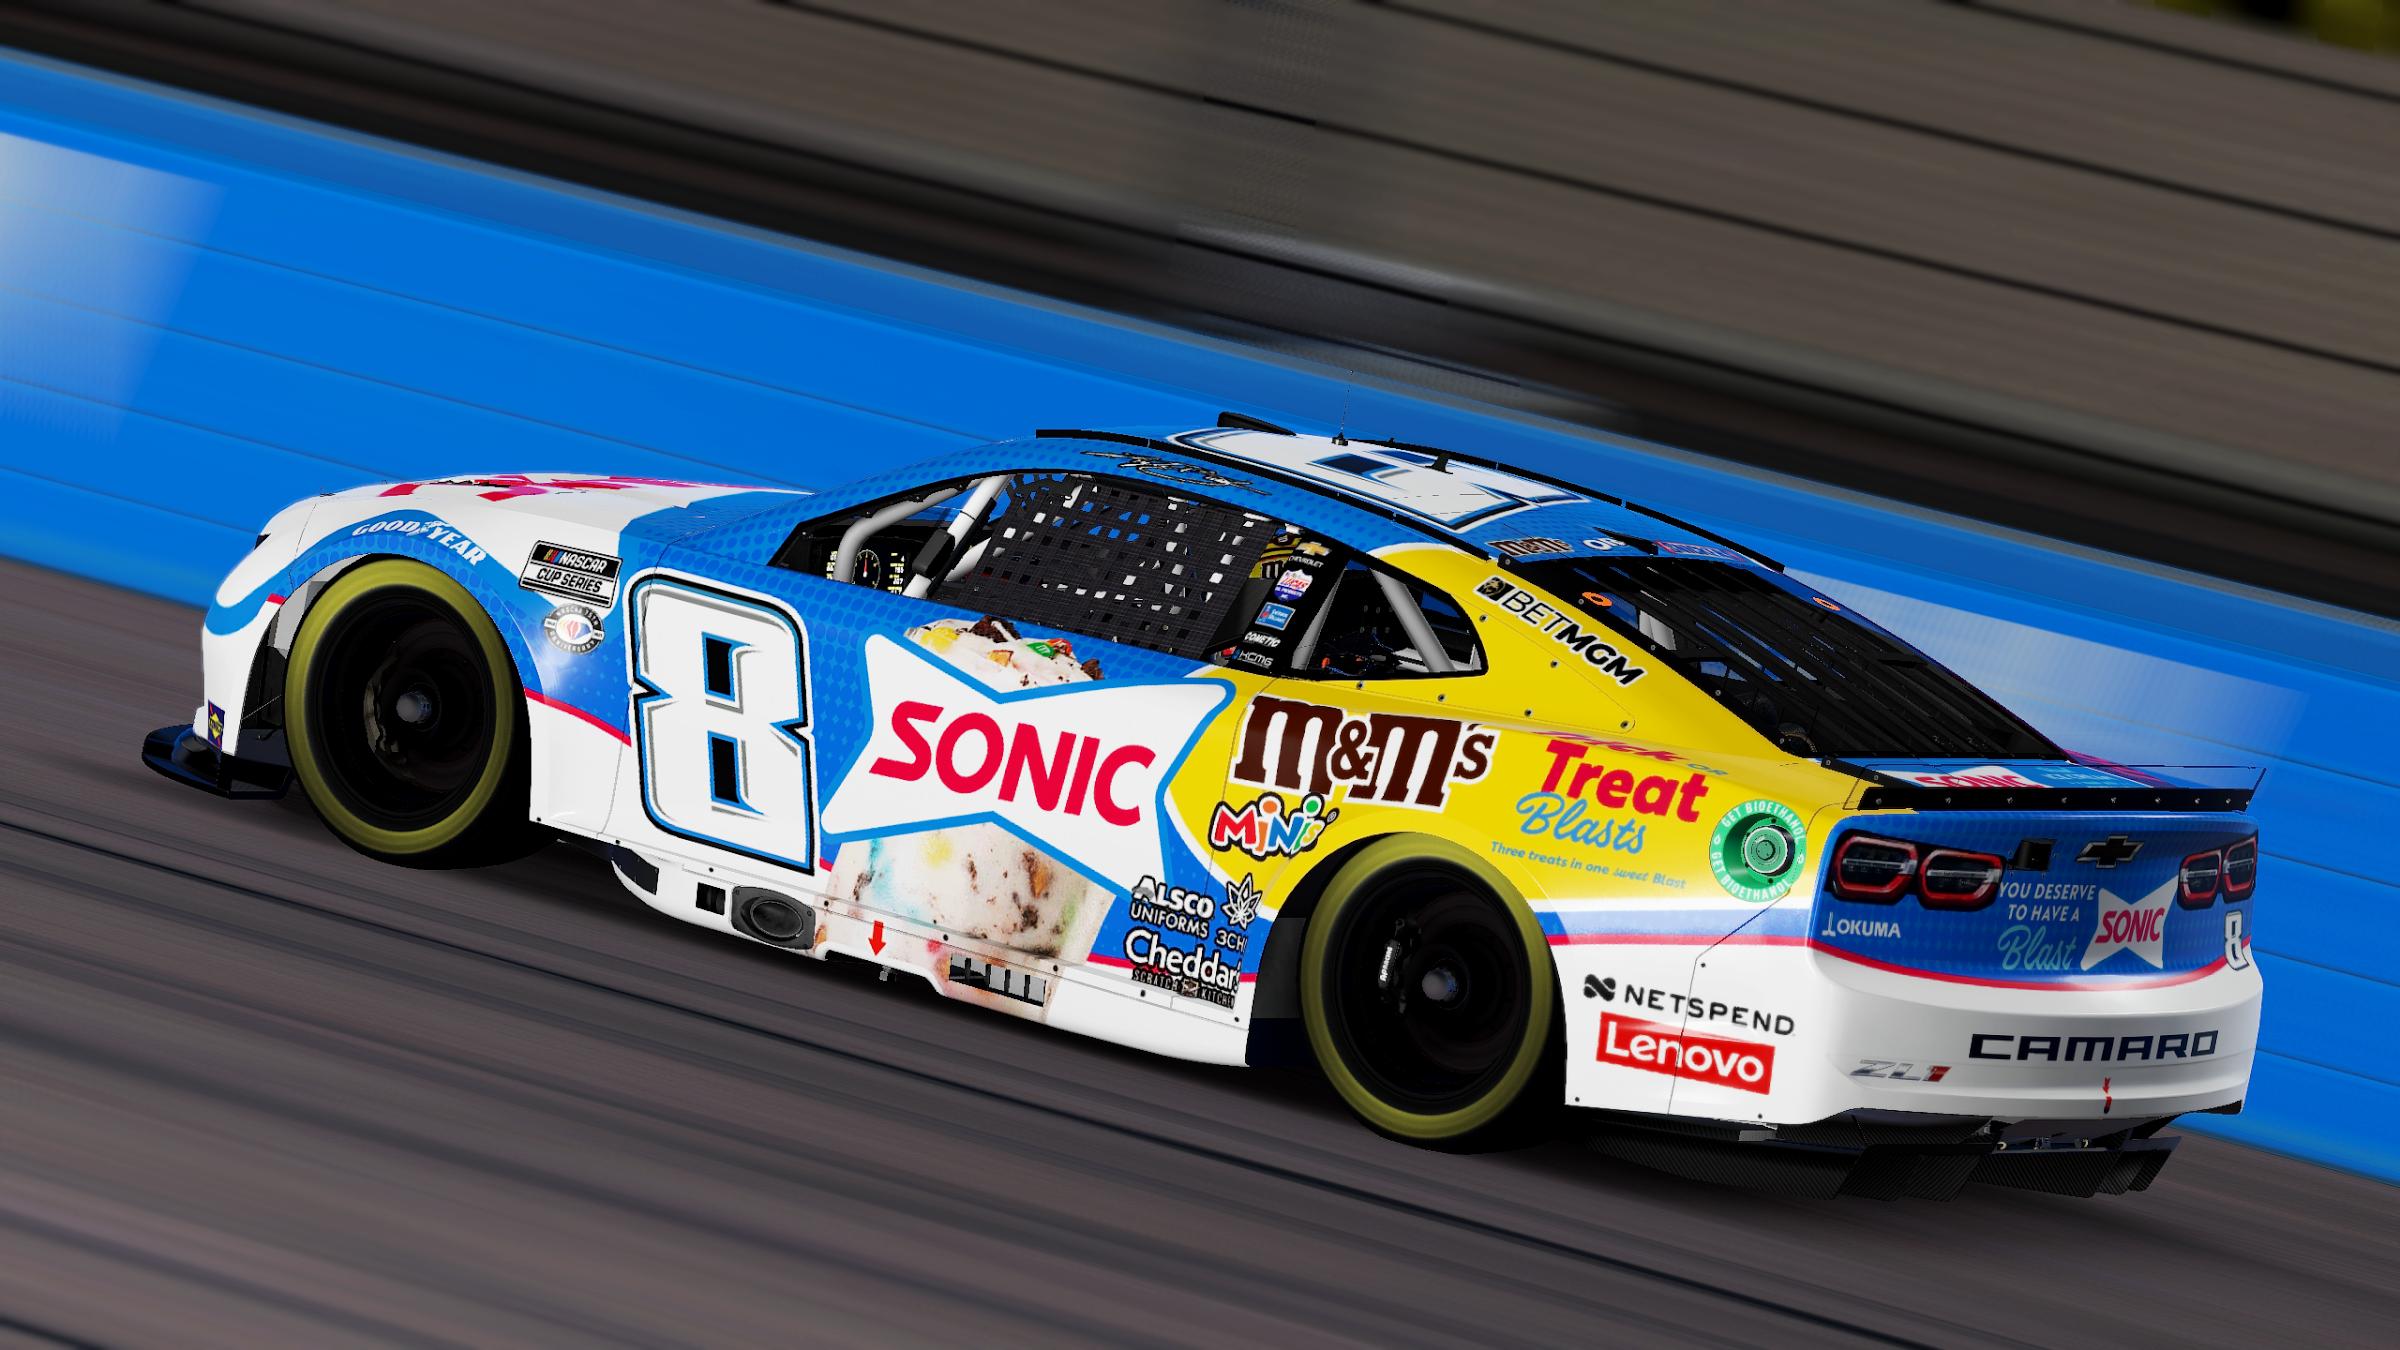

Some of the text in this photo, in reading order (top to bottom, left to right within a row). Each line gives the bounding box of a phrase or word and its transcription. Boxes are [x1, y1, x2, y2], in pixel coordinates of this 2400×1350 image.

[351, 519, 487, 566] GOODYEAR
[558, 551, 608, 574] NASCAR
[536, 567, 603, 593] CUP SERIES
[1501, 590, 1645, 686] BETMGM
[629, 573, 815, 876] 8
[868, 700, 1156, 827] SONIC
[1541, 738, 1709, 822] Treat
[1515, 791, 1647, 854] Blasts
[1721, 807, 1742, 828] GET
[1491, 840, 1526, 858] Three
[1528, 850, 1568, 868] treats
[1570, 857, 1583, 870] in
[1585, 862, 1610, 874] one
[1652, 872, 1688, 889] Blast
[1999, 881, 2096, 900] YOU DESERVE
[2008, 904, 2080, 922] TO HAVE A
[1131, 902, 1209, 938] UNIFORMS
[1836, 918, 1901, 938] OKUMA
[2095, 907, 2165, 944] SONIC
[1997, 925, 2077, 970] Blast
[1624, 984, 1795, 1036] NETSPEND
[1605, 1021, 1764, 1082] Lenovo
[1968, 1030, 2219, 1061] CAMARO
